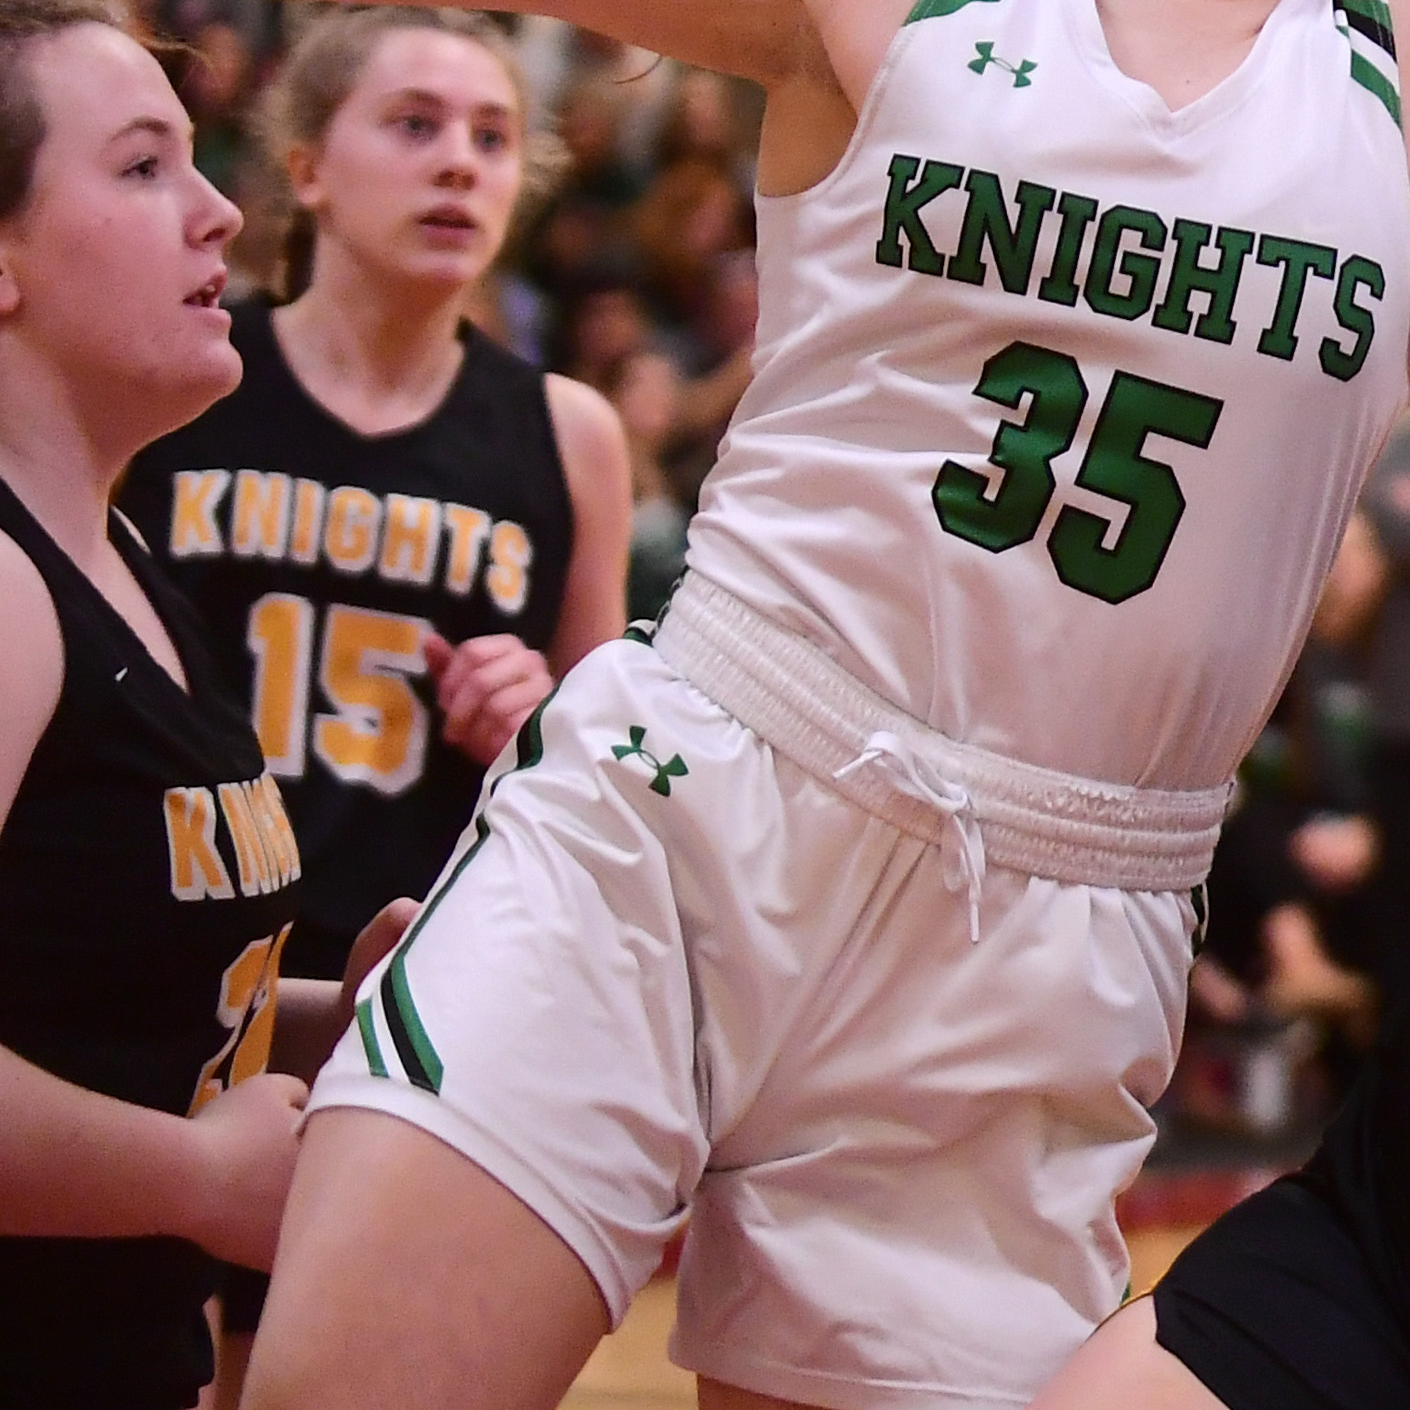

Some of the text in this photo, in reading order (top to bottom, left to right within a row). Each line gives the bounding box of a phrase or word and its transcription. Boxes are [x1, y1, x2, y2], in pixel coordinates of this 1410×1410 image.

[875, 153, 1386, 382] KNIGHTS
[168, 468, 534, 613] KNIGHTS
[931, 340, 1225, 605] 35
[248, 592, 434, 794] 15
